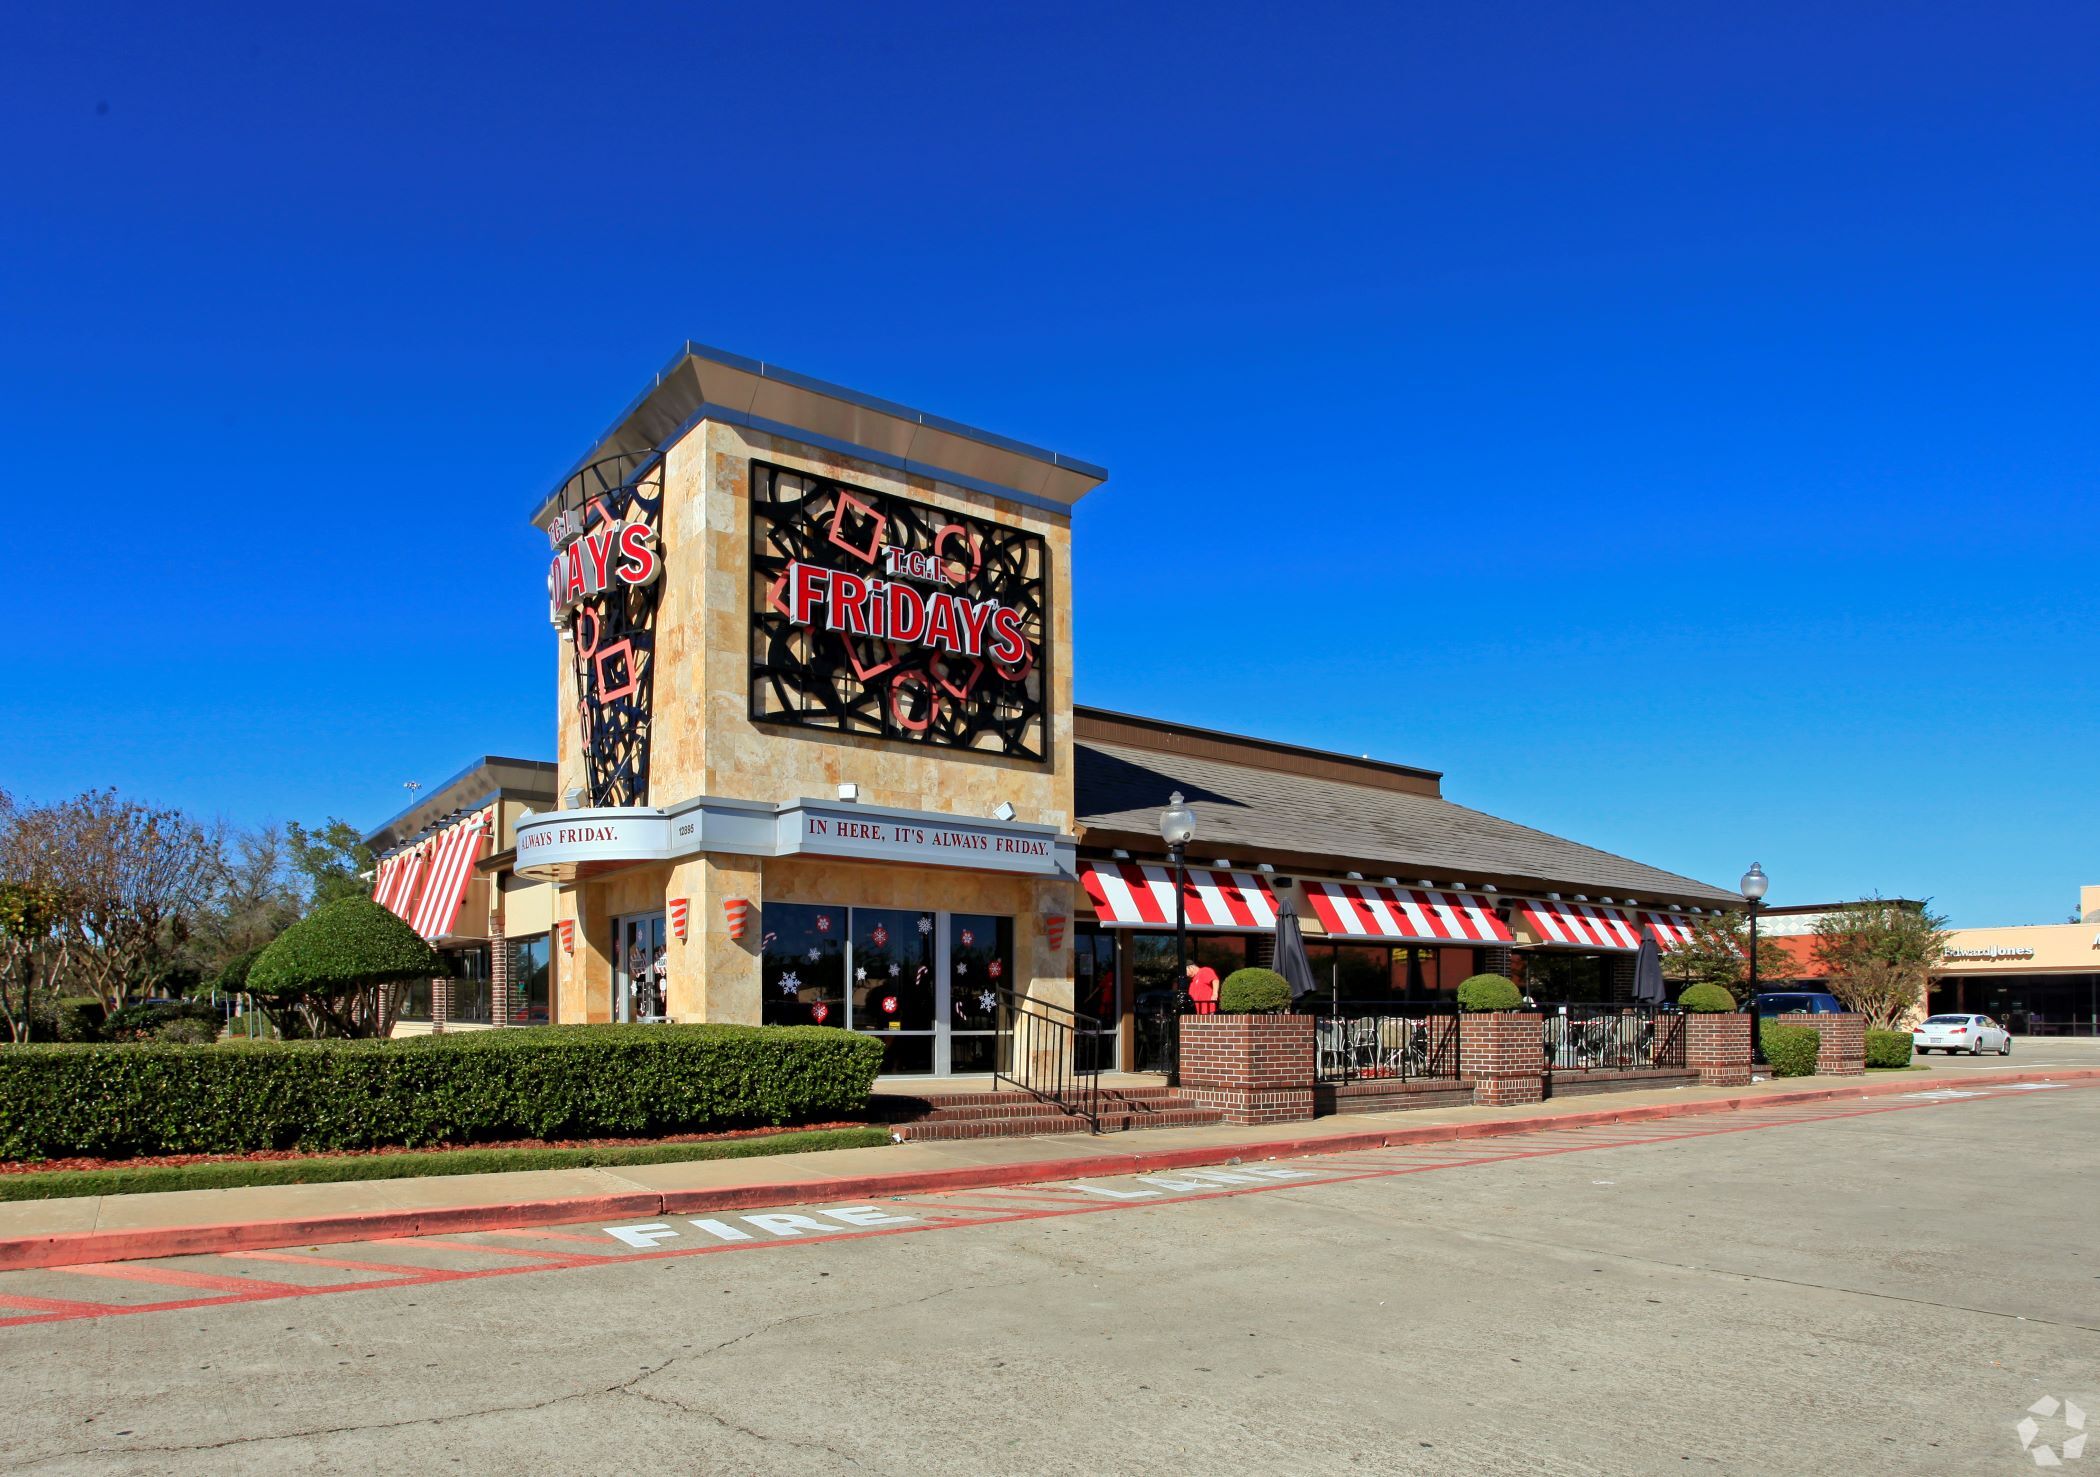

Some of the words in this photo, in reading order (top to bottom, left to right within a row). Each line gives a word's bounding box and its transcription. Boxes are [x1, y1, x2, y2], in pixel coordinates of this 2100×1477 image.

[884, 545, 949, 584] T.G.I.
[521, 831, 553, 851] ALWAYS
[559, 826, 618, 844] FRIDAY.
[808, 818, 828, 835] IN
[837, 821, 886, 843] HERE,
[894, 827, 925, 845] IT'S
[932, 832, 988, 851] ALWAYS
[996, 837, 1050, 857] FRIDAY.
[603, 1205, 921, 1249] FIRE
[1068, 1166, 1315, 1199] LANE
